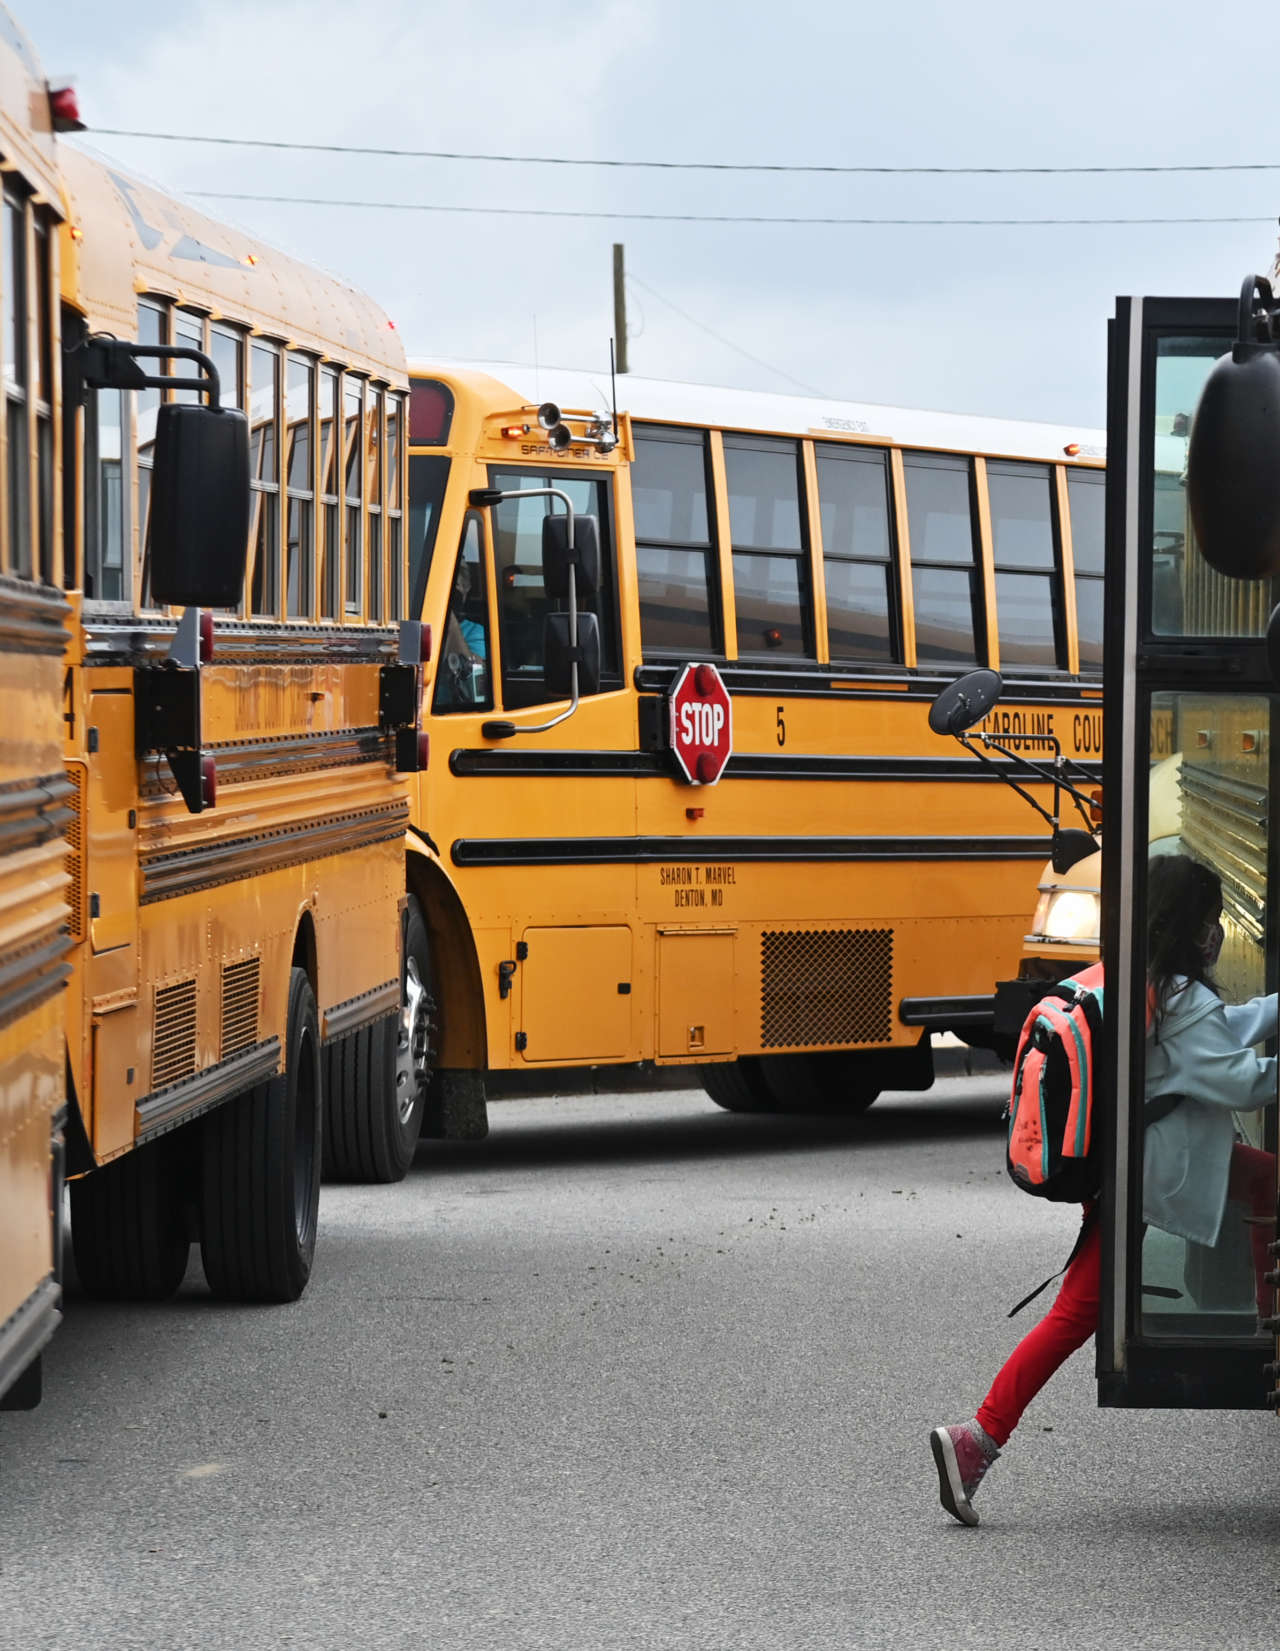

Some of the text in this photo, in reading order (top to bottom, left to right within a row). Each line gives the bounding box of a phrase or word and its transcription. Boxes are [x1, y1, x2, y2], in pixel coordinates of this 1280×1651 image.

[681, 702, 725, 747] STOP
[776, 706, 786, 747] 5
[982, 711, 1055, 751] CAROLINE
[660, 866, 736, 885] SHARON T. MARVEL
[711, 888, 723, 907] MD
